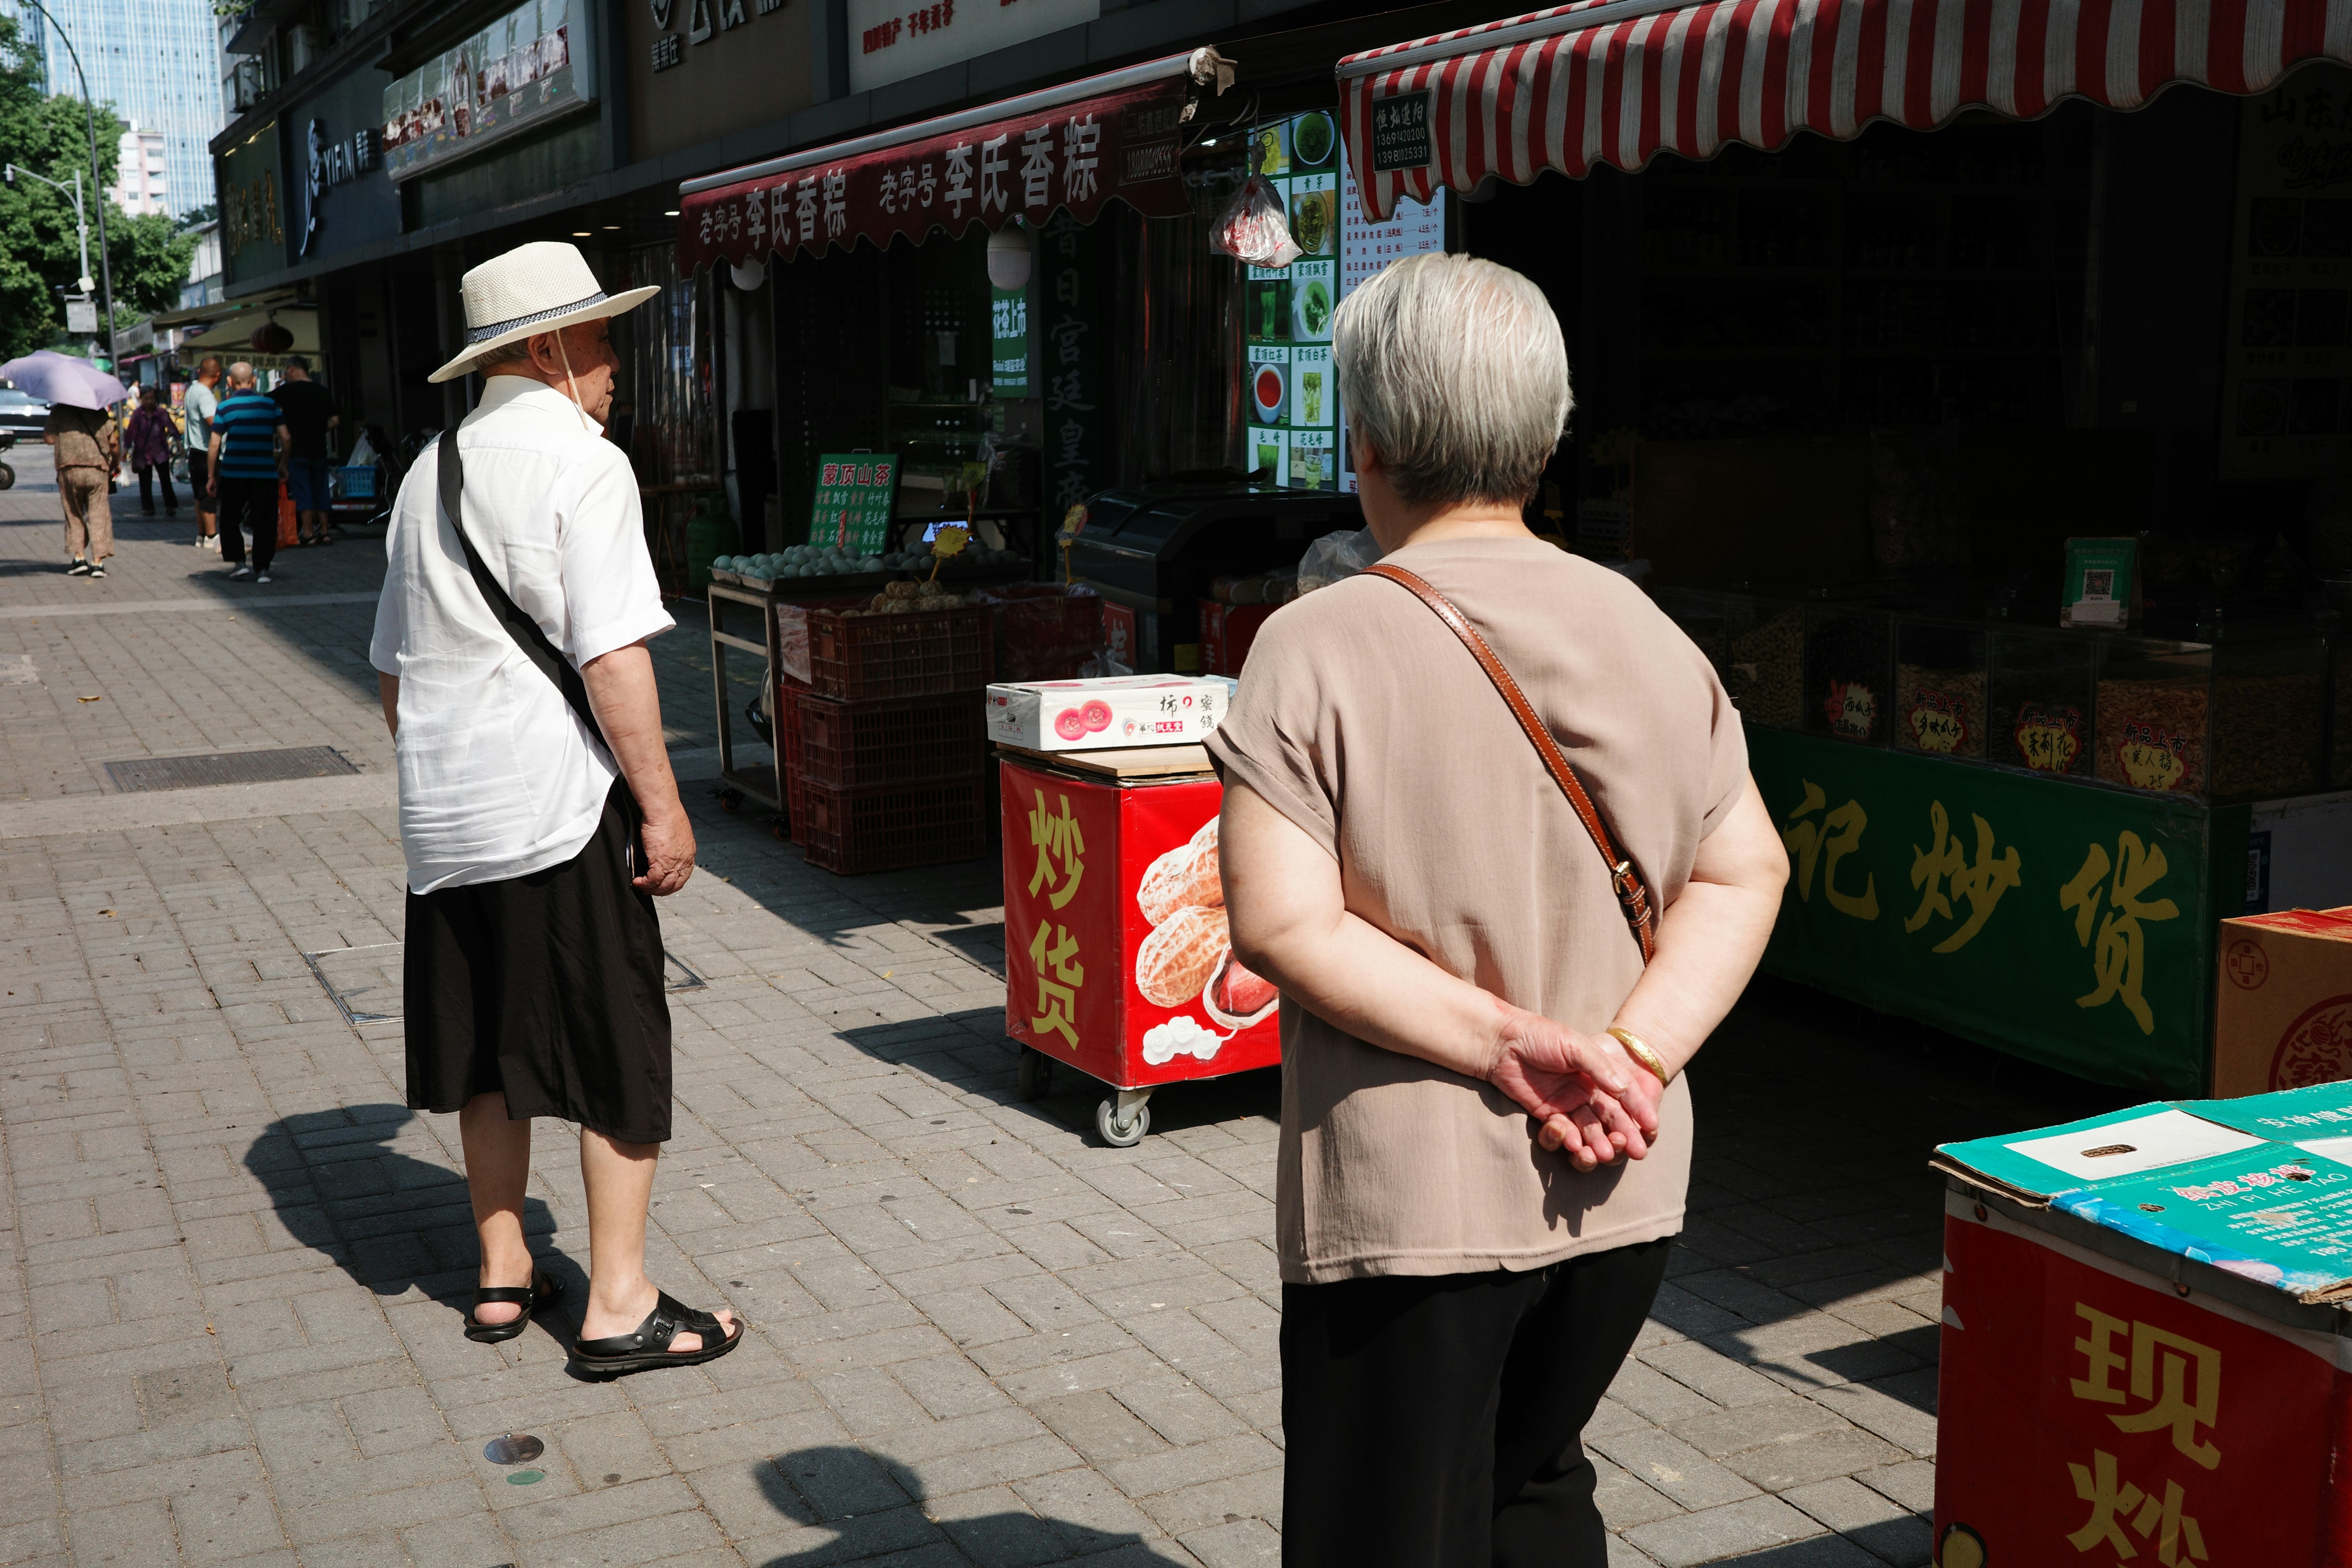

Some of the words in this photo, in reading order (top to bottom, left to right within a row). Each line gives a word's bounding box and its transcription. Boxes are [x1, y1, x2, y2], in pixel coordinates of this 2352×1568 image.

[700, 203, 741, 245] 老字号
[746, 167, 846, 250] 李氏香粽
[879, 163, 937, 214] 老字号
[944, 113, 1101, 220] 李氏香粽
[992, 297, 1026, 339] 花茶上市
[1254, 348, 1283, 361] 蒙顶红茶
[1298, 347, 1328, 362] 蒙顶白茶
[1259, 431, 1280, 444] 毛峰
[1300, 433, 1323, 446] 花毛峰
[822, 463, 892, 487] 蒙顶山茶
[867, 491, 890, 507] 竹叶春
[864, 510, 887, 526] 花毛峰
[862, 529, 885, 546] 黄金芽
[1845, 697, 1873, 717] 西瓜子
[1915, 687, 1965, 720] 新品上市
[1918, 712, 1962, 738] 多味瓜子
[2020, 705, 2078, 732] 新品上市
[2123, 720, 2186, 756] 新品上市
[1028, 788, 1085, 1051] 炒货
[1782, 778, 2181, 1035] 记炒货
[2198, 1198, 2238, 1211] ZHI
[2239, 1194, 2266, 1206] PI
[2271, 1185, 2303, 1198] HE
[2301, 1173, 2348, 1187] TAO
